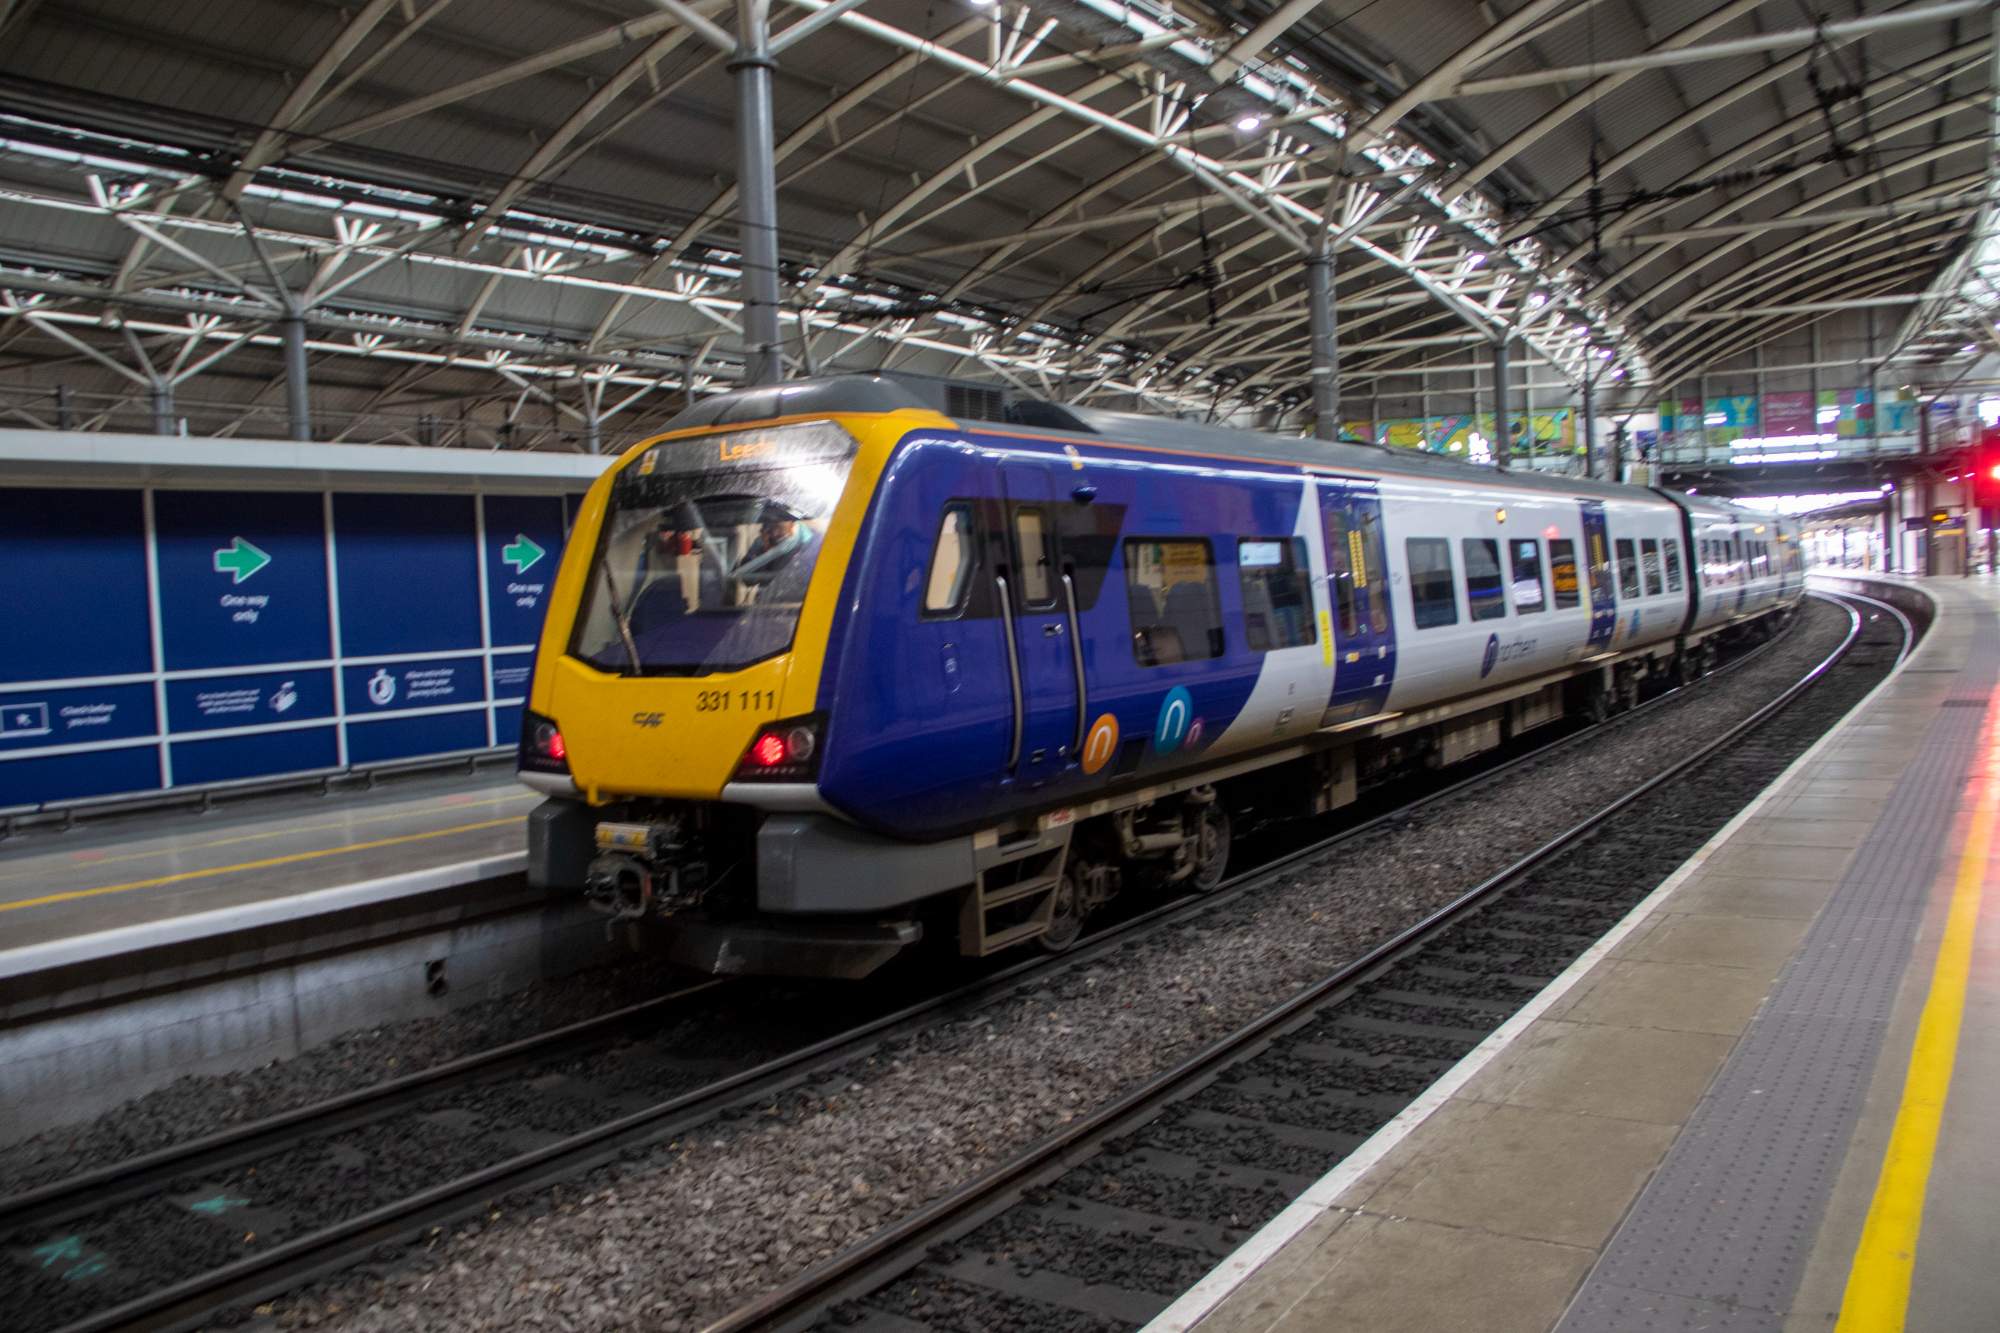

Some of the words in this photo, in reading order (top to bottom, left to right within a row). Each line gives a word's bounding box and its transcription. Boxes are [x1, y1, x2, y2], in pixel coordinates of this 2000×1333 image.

[220, 594, 245, 607] One
[246, 595, 270, 608] way
[232, 608, 259, 624] only
[696, 690, 730, 712] 331
[739, 690, 775, 711] 111
